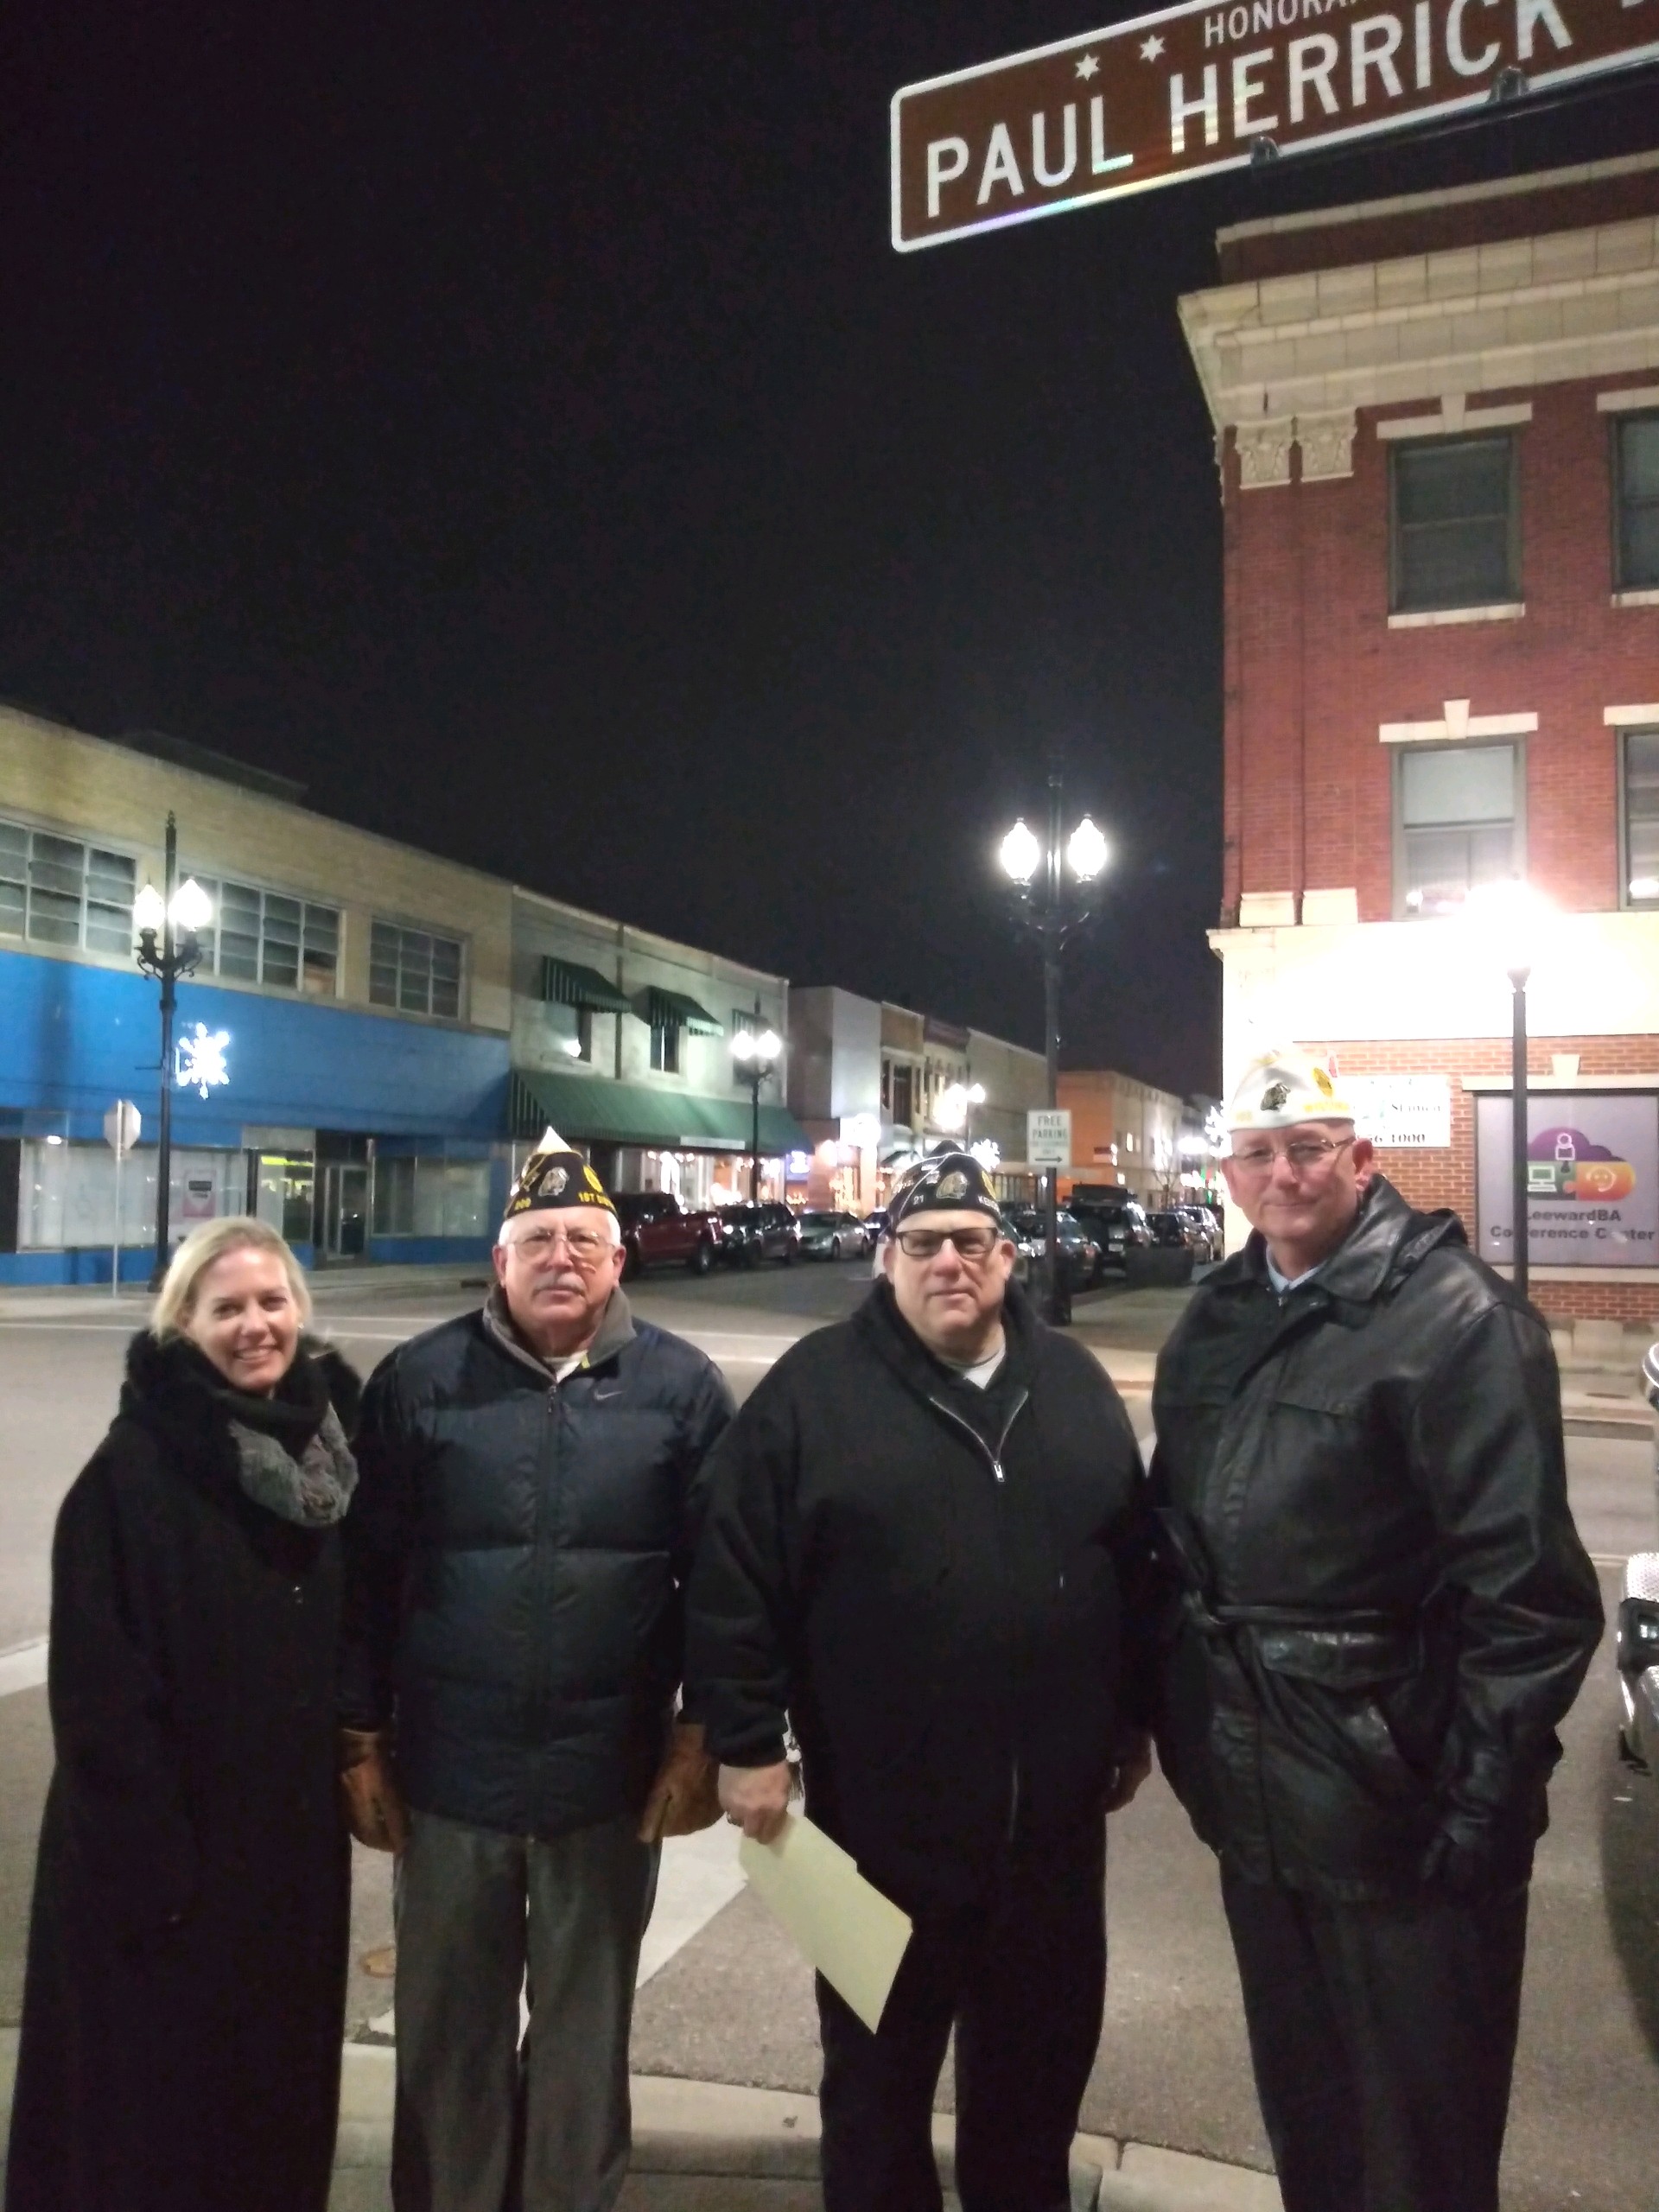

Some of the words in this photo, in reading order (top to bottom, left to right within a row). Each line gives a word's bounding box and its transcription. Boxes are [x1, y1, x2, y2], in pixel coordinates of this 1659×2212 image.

[1205, 0, 1358, 48] HONOR
[925, 93, 1135, 219] PAUL
[1170, 0, 1573, 156] HERRICK
[1037, 1116, 1062, 1127] FREE
[1032, 1128, 1068, 1139] PARKING
[1491, 1225, 1589, 1239] Coerence
[1595, 1227, 1656, 1241] Cter
